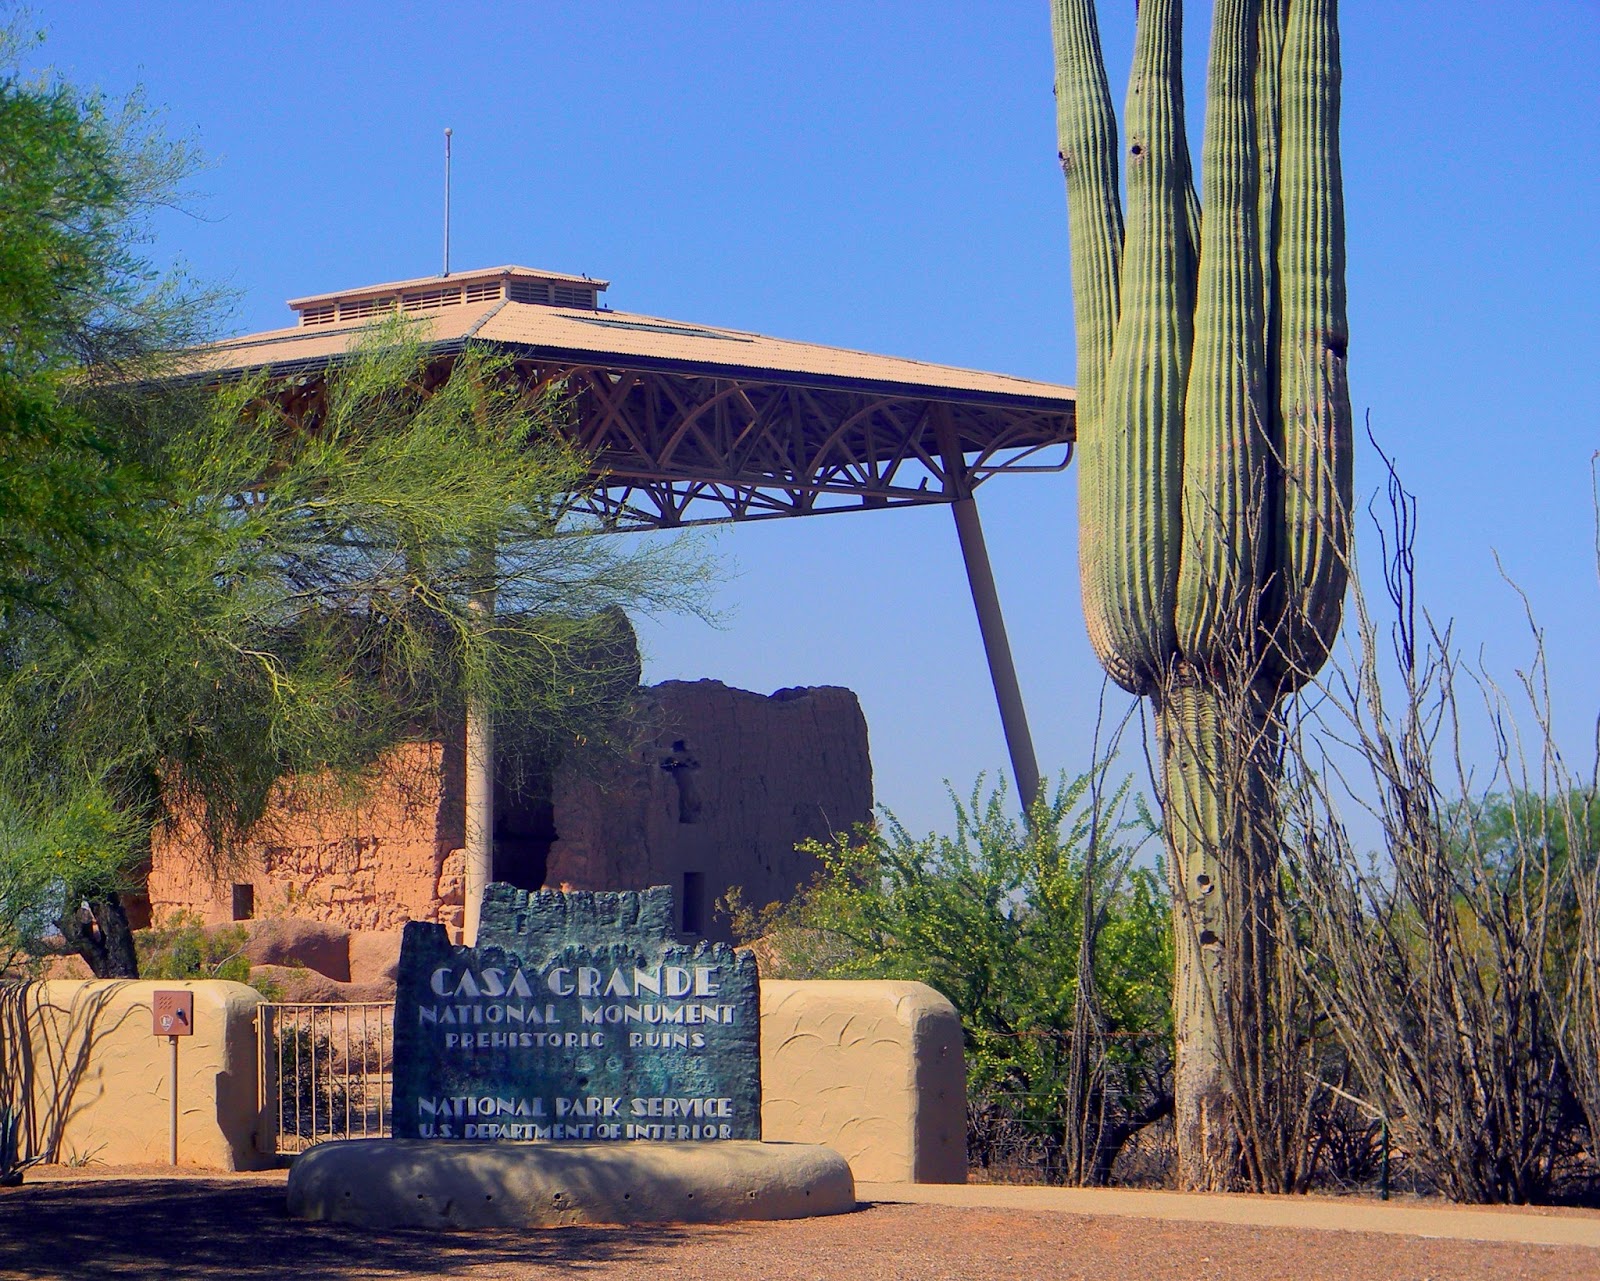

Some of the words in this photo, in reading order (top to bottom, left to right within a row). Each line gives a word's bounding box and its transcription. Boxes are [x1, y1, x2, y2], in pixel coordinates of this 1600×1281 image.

[430, 967, 533, 998] CASA
[548, 966, 720, 998] GRANDE
[419, 1004, 560, 1025] NATIONAL
[581, 1004, 736, 1025] MONUMENT
[445, 1032, 605, 1049] PREHISTORIC
[629, 1032, 706, 1049] RUINS
[417, 1097, 547, 1118] NATIONAL
[555, 1097, 622, 1118] PARK
[630, 1097, 733, 1118] SERVICE
[464, 1123, 594, 1139] DEPARTMENT
[596, 1123, 621, 1139] OF
[626, 1123, 732, 1139] INTERIOR
